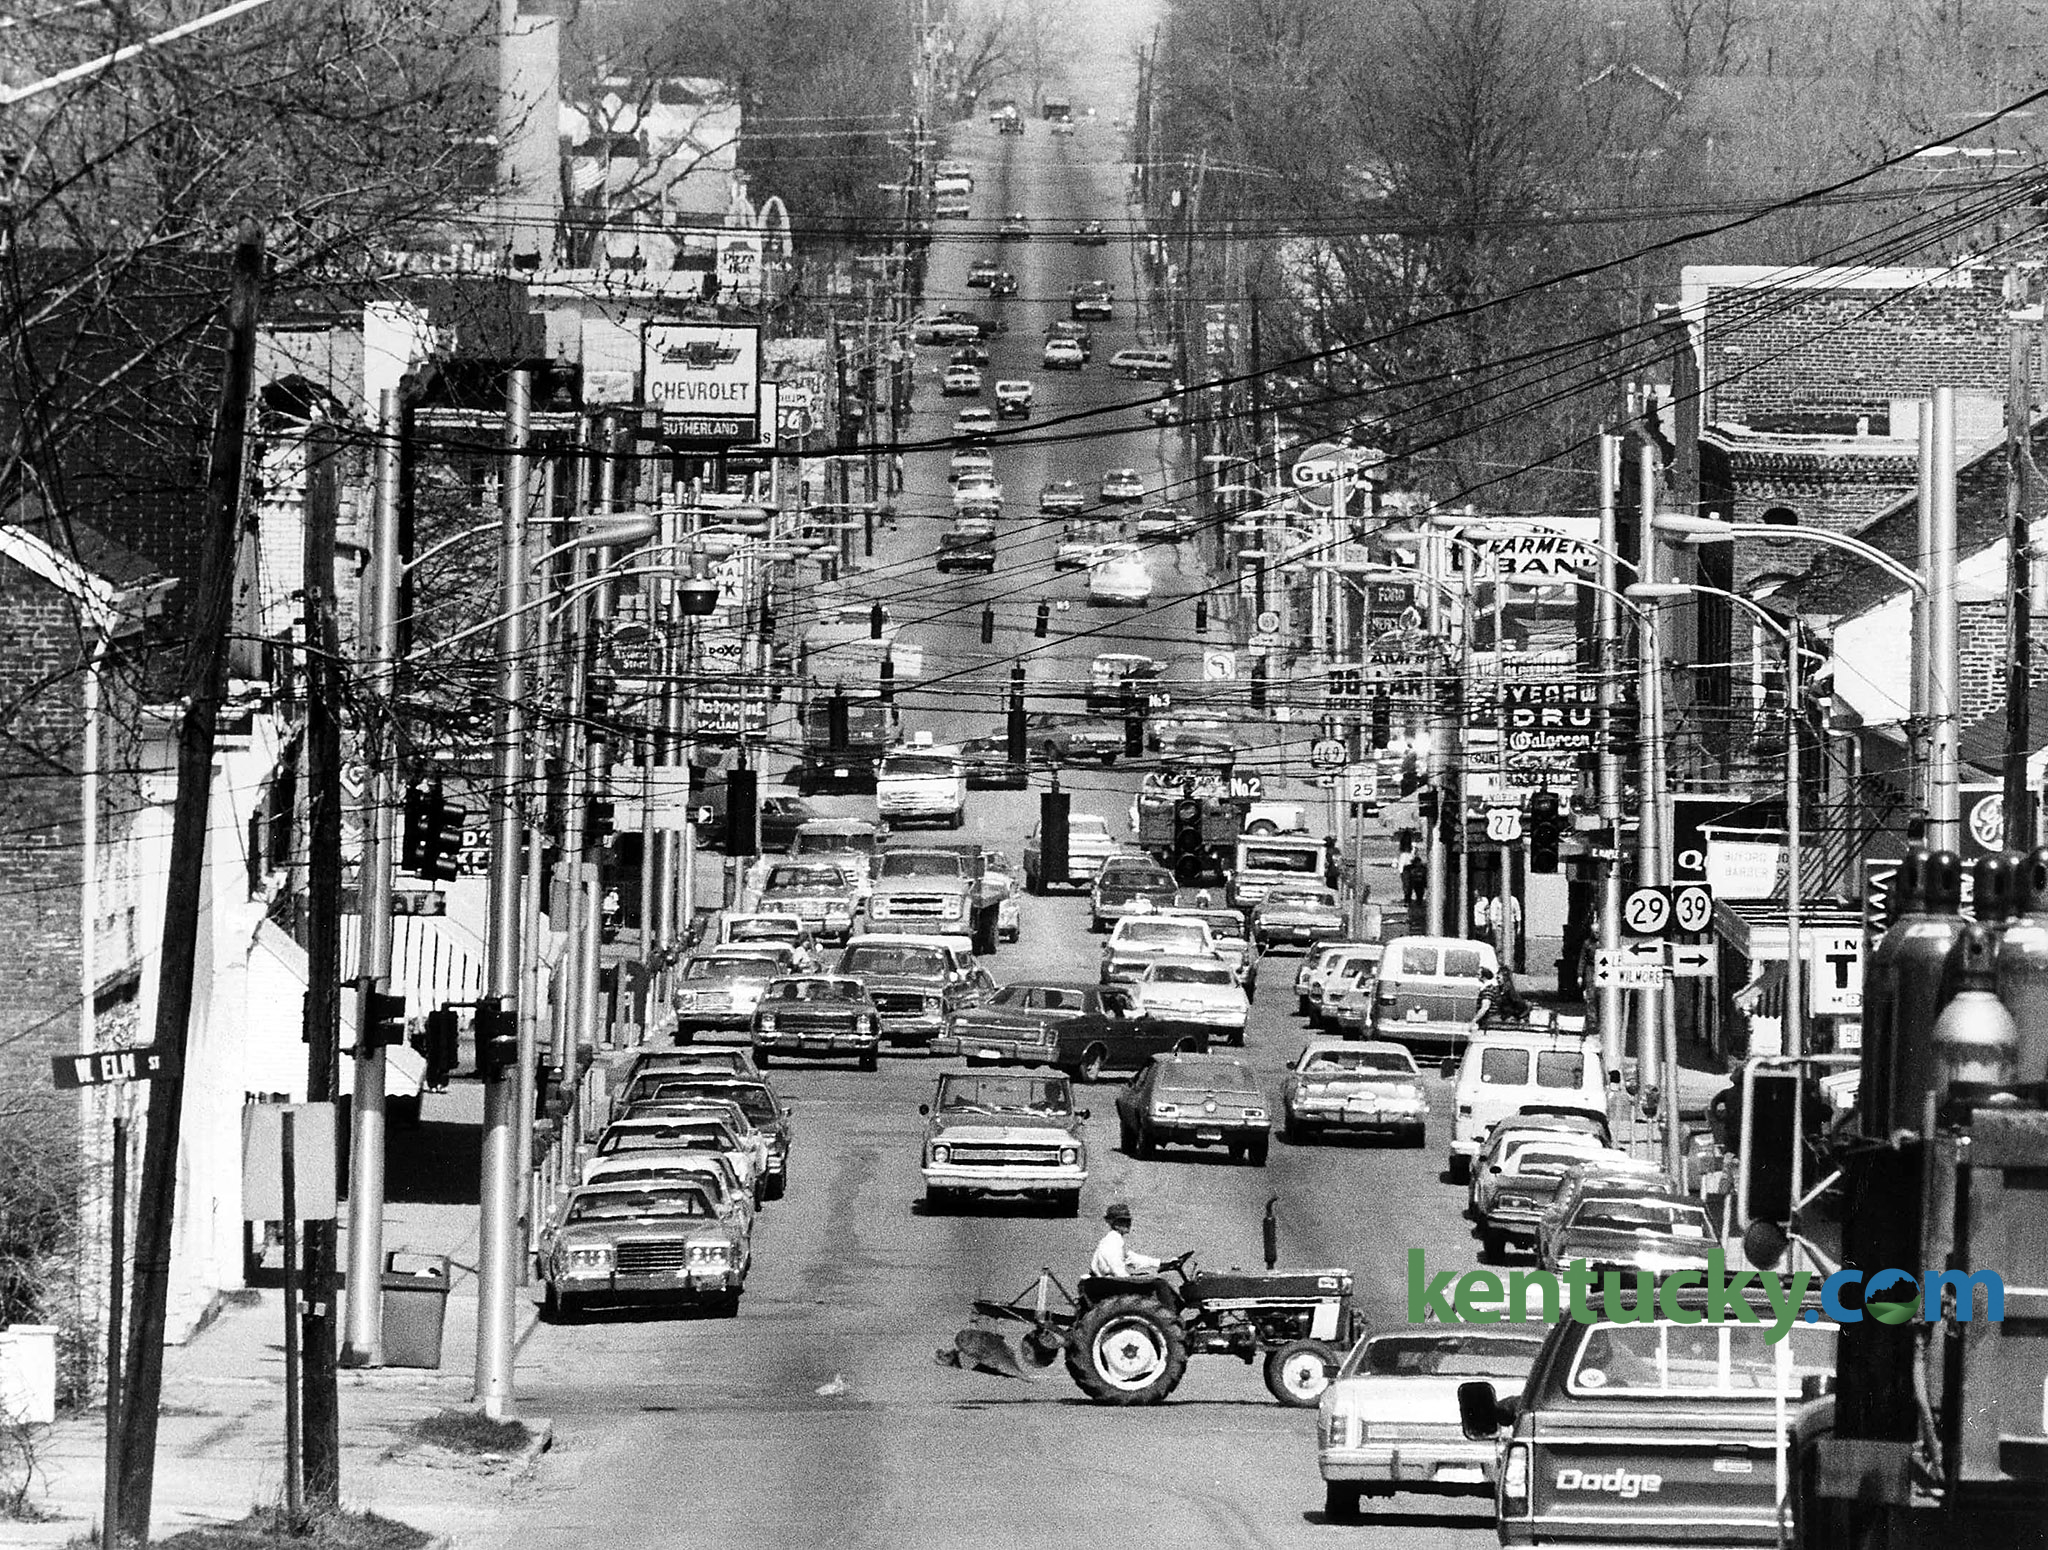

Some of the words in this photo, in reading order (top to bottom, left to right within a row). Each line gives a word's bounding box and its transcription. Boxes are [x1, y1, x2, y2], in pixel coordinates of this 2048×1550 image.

[652, 381, 749, 400] CHEVROLET
[663, 422, 739, 436] SUTHERLAND
[1354, 784, 1373, 796] 25
[1495, 815, 1514, 835] 27
[1632, 897, 1663, 924] 29
[1682, 896, 1706, 923] 39
[1619, 970, 1663, 984] WILMORE
[101, 1053, 135, 1081] ELM
[148, 1055, 160, 1070] ST
[1556, 1468, 1662, 1498] Dodge
